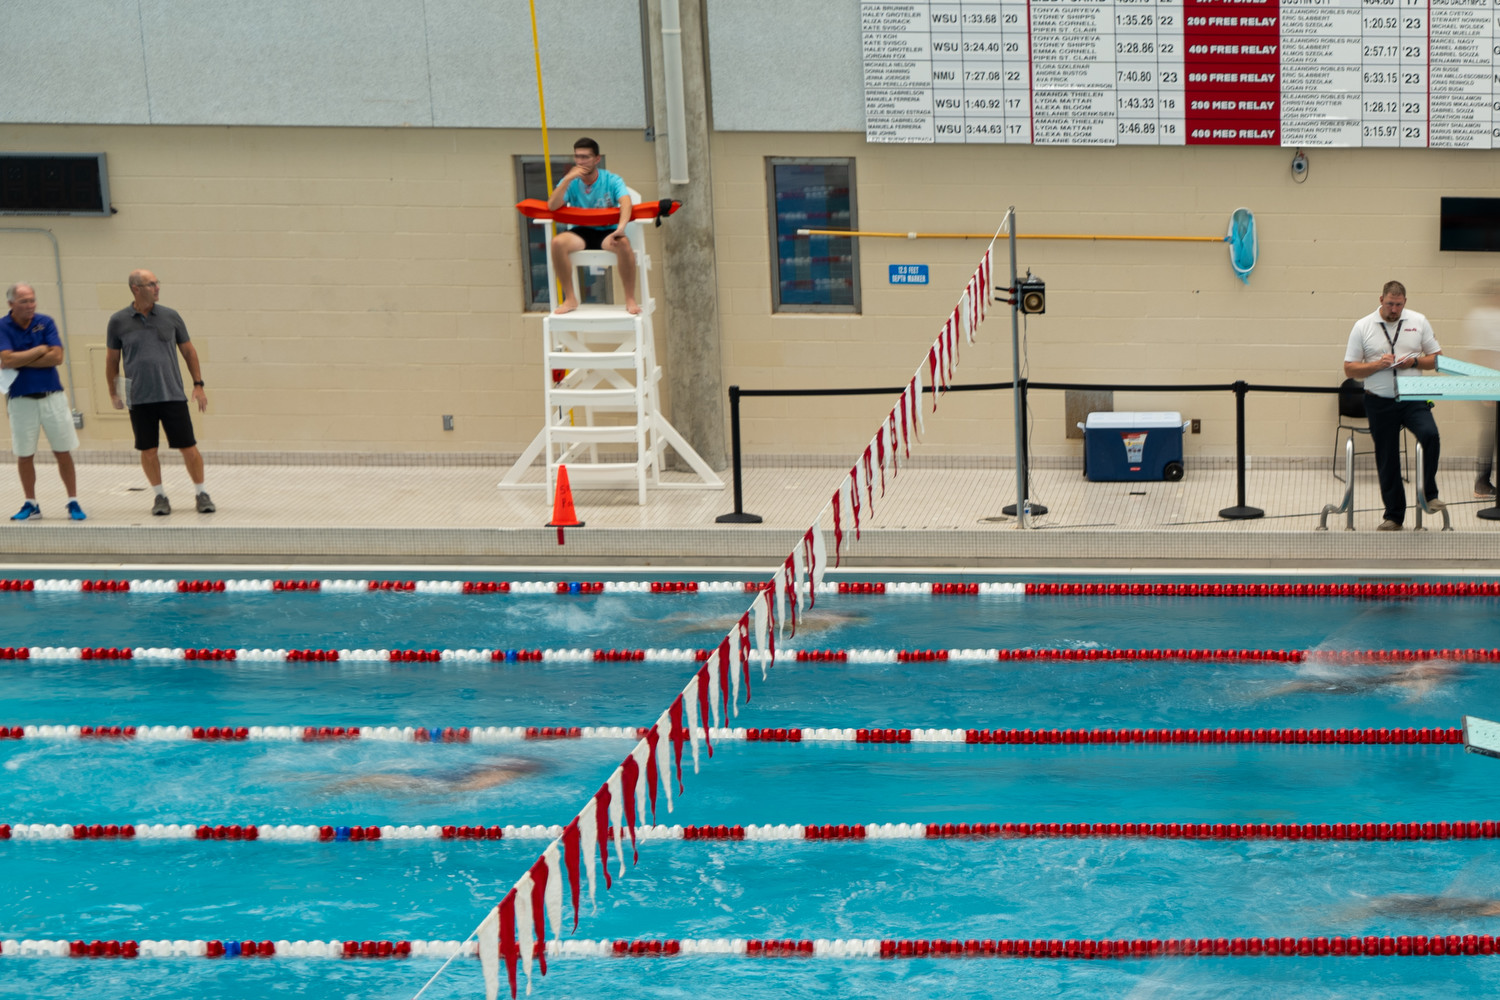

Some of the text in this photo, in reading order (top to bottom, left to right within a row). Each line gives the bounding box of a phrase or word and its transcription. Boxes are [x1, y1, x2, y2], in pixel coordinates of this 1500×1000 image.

[932, 14, 957, 24] WSU
[963, 14, 997, 24] 1:33.68
[1003, 14, 1018, 24] '20
[1117, 15, 1153, 26] 1:35.26
[1158, 16, 1173, 26] '22
[1187, 17, 1277, 27] 200 FREE RELAY
[1364, 18, 1397, 29] 1:20.52
[1403, 18, 1421, 29] '23
[934, 42, 959, 52] WSU
[964, 42, 999, 52] 3:24.40
[1004, 42, 1019, 52] '20
[1117, 43, 1153, 53] 3:28.86
[1159, 44, 1174, 53] '22
[1189, 45, 1277, 55] 400 FREE RELAY
[1364, 46, 1398, 57] 2:57.17
[1402, 46, 1421, 57] '23
[934, 71, 955, 80] NMU
[965, 71, 1000, 81] 7:27.08
[1005, 71, 1020, 81] '22
[1118, 71, 1152, 82] 7:40.80
[1160, 72, 1178, 83] '23
[1189, 73, 1276, 83] 800 FREE RELAY
[1364, 72, 1397, 83] 6:33.15
[1402, 73, 1420, 84] '23
[936, 99, 961, 108] WSU
[966, 99, 1000, 109] 1:40.92
[1006, 99, 1021, 108] '17
[1119, 98, 1155, 109] 1:43.33
[1160, 99, 1175, 108] '18
[1191, 101, 1275, 111] 200 MED RELAY
[1364, 101, 1397, 113] 1:28.12
[1402, 102, 1420, 113] '23
[937, 125, 962, 134] WSU
[967, 124, 1002, 134] 3:44.63
[1007, 125, 1022, 134] '17
[1119, 123, 1156, 134] 3:46.89
[1161, 124, 1176, 133] '18
[1364, 126, 1397, 137] 3:15.97
[1402, 127, 1421, 138] '23
[1191, 129, 1276, 139] 400 MED RELAY
[908, 266, 919, 274] FEET
[892, 274, 926, 283] DEPTH MARKER
